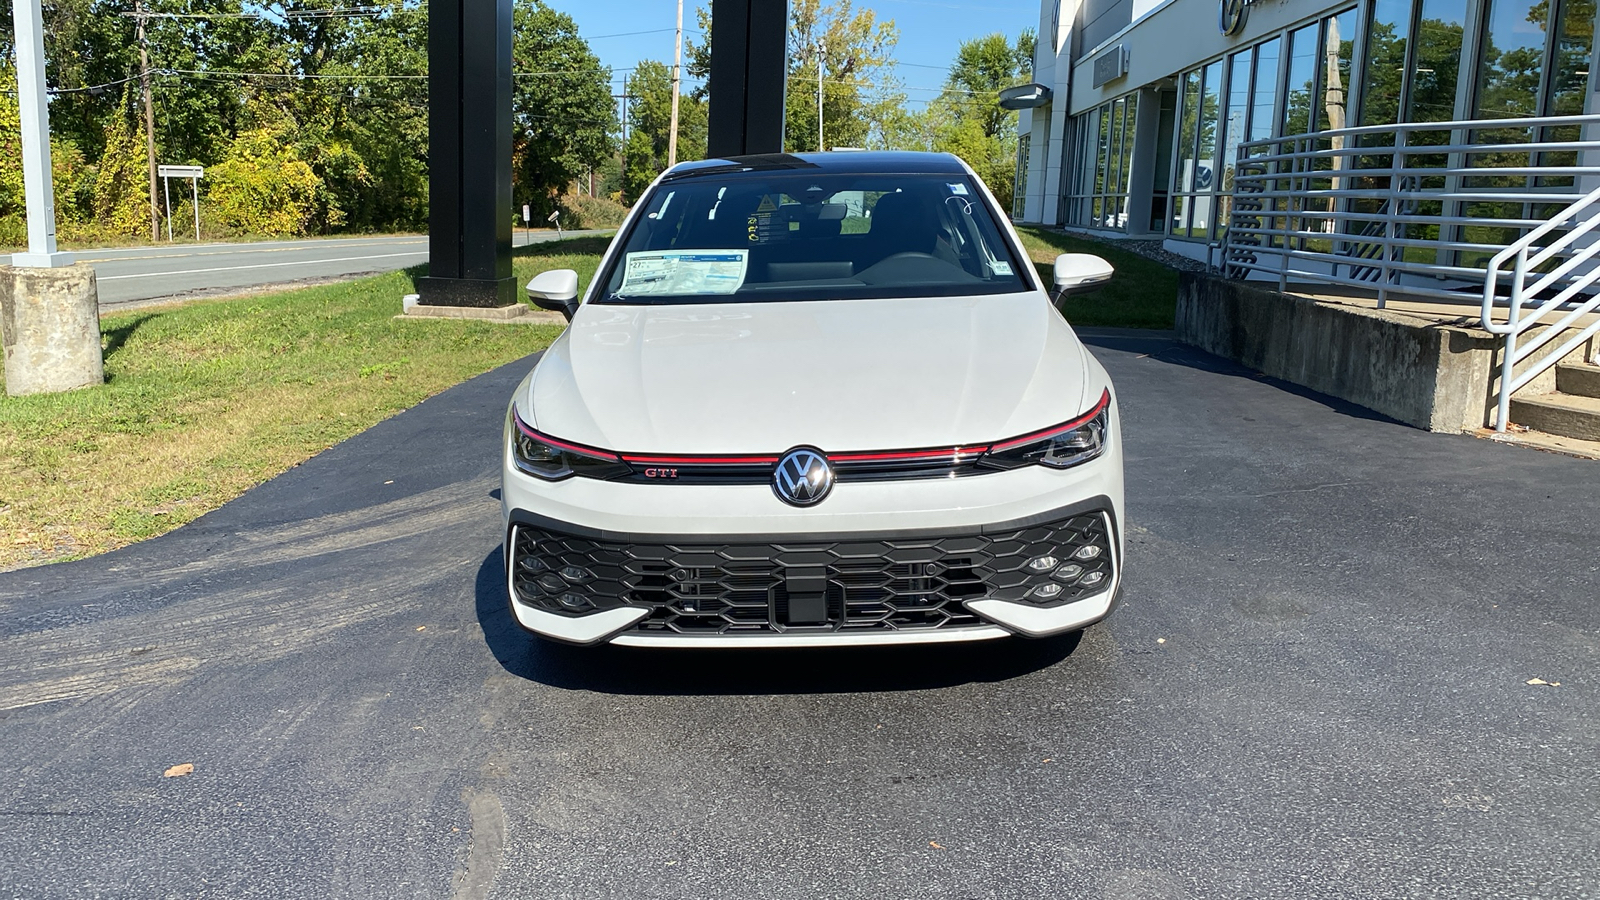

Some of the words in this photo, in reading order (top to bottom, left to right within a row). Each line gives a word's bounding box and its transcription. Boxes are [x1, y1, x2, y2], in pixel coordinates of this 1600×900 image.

[632, 261, 642, 269] 27
[644, 468, 678, 478] GTI
[777, 452, 830, 501] VW
